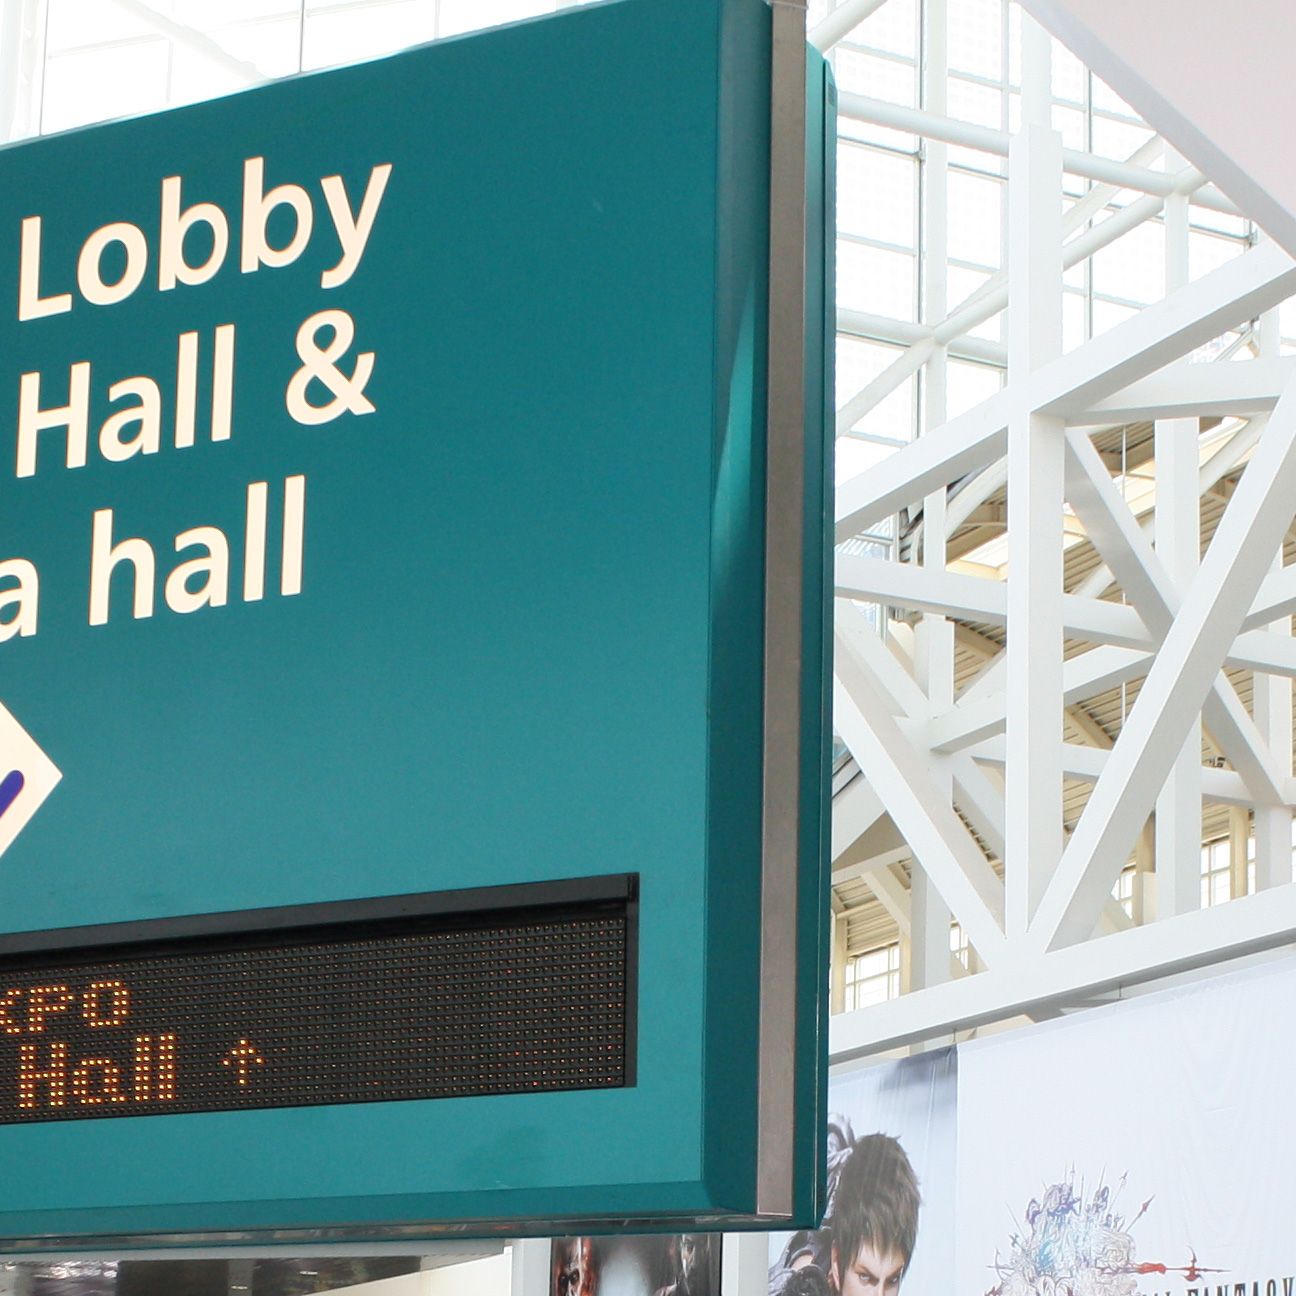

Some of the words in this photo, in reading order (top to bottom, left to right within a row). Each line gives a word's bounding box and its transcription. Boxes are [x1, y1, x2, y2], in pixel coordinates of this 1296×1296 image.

[17, 158, 393, 323] Lobby
[15, 322, 236, 479] Hall
[284, 308, 379, 426] &
[87, 475, 306, 628] hall
[17, 1031, 180, 1111] Hall
